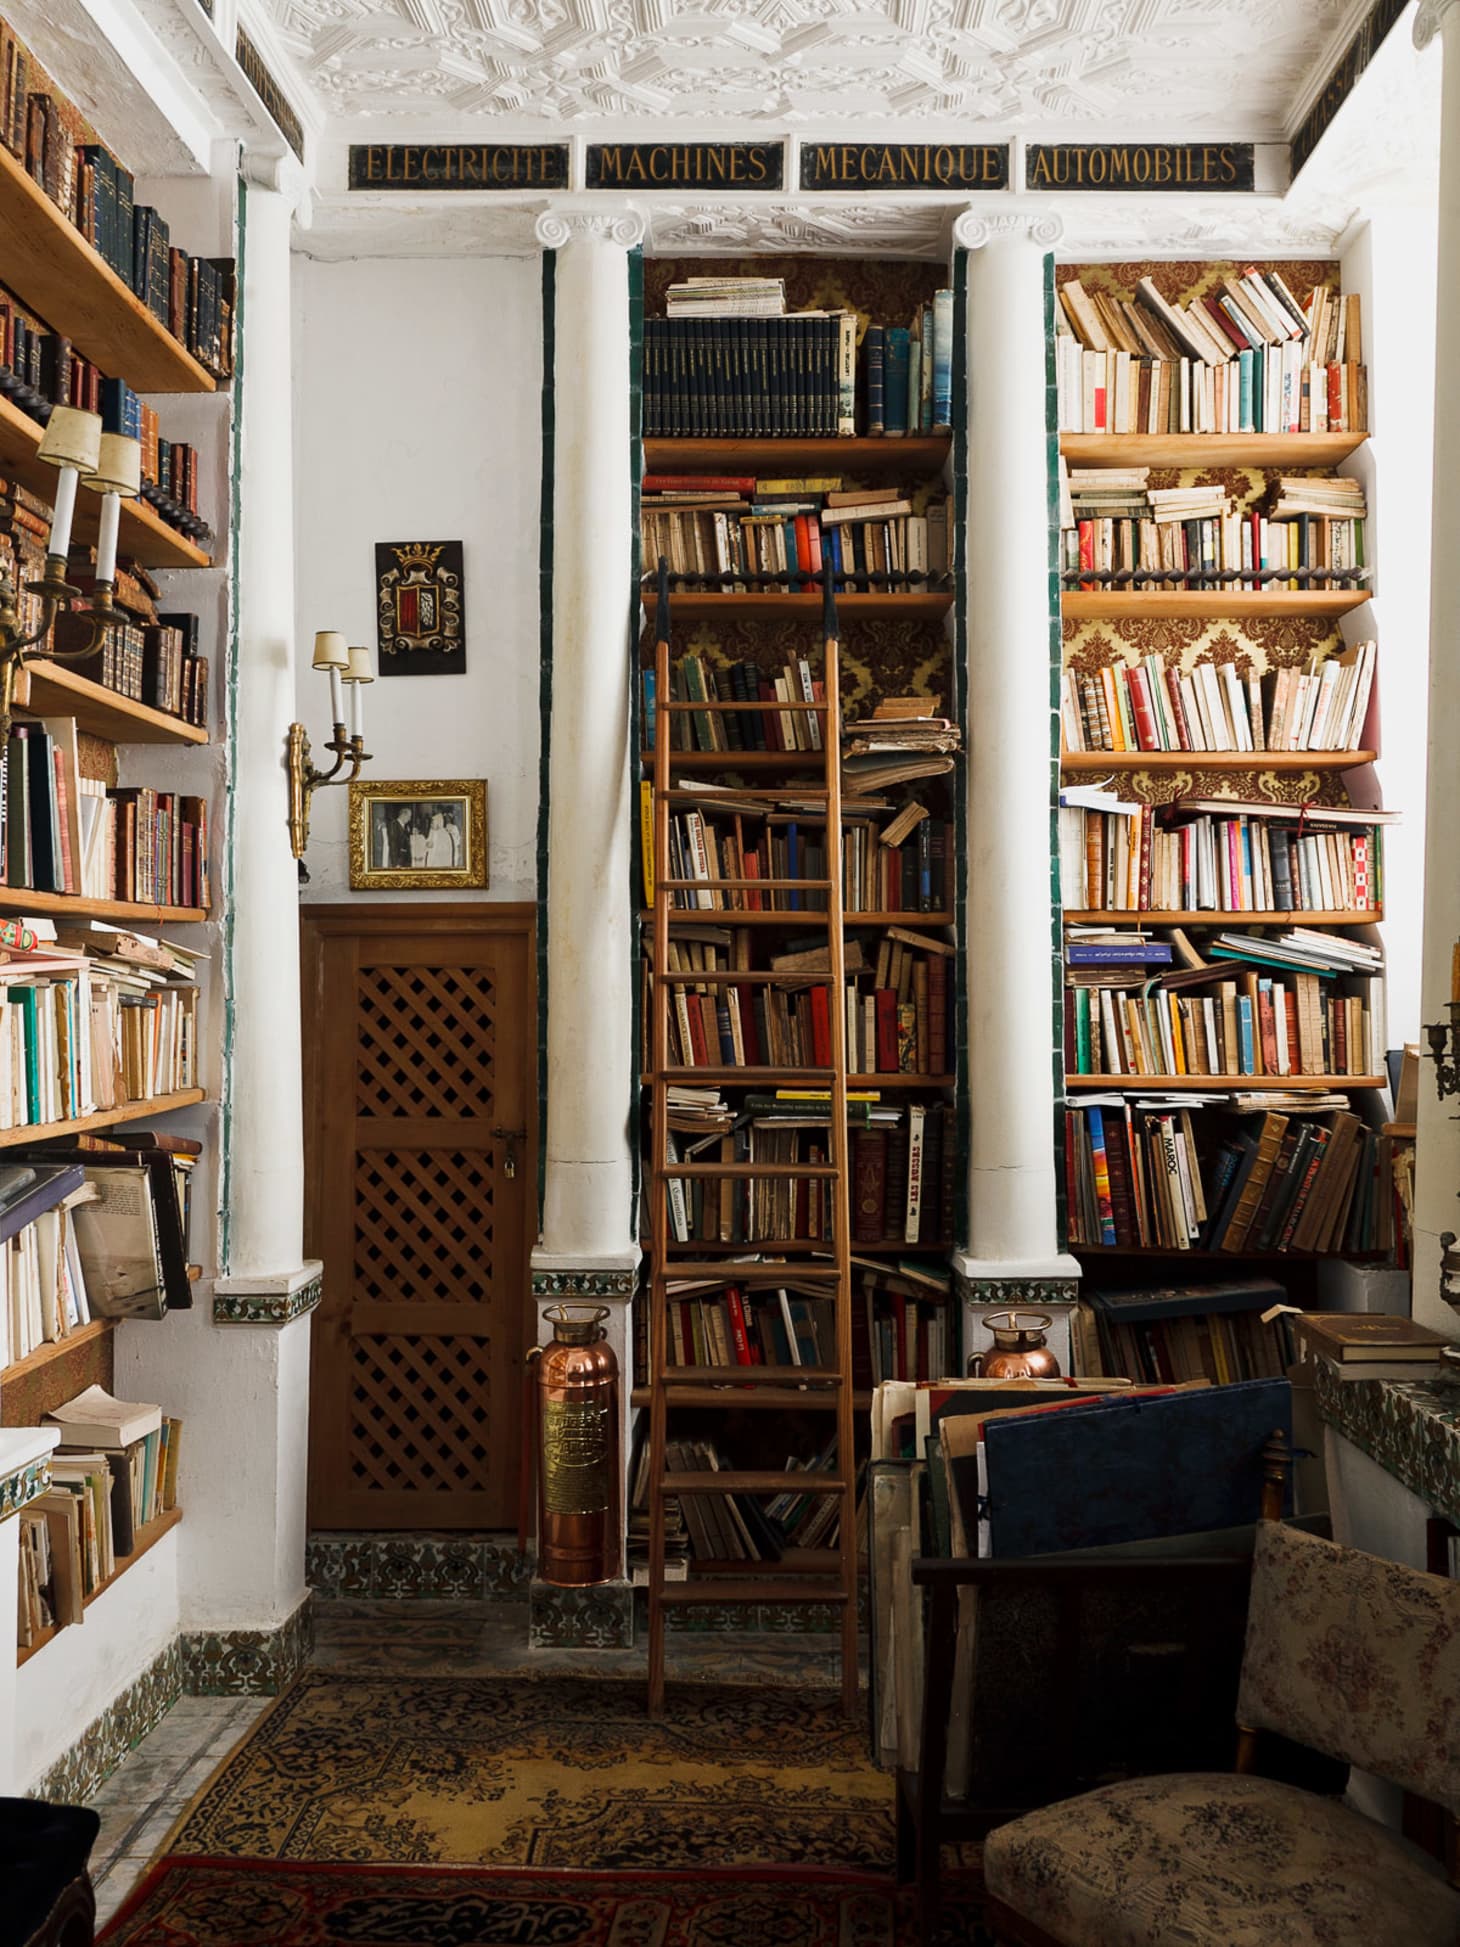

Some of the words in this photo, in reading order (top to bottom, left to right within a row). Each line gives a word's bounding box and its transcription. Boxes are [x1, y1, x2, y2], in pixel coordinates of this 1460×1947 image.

[365, 147, 557, 181] ELECTRICITE
[600, 146, 768, 181] MACHINES
[814, 145, 998, 184] MECANIQUE
[1032, 147, 1238, 182] AUTOMOBILES
[1164, 1138, 1177, 1175] MAROC
[910, 1185, 918, 1201] LES
